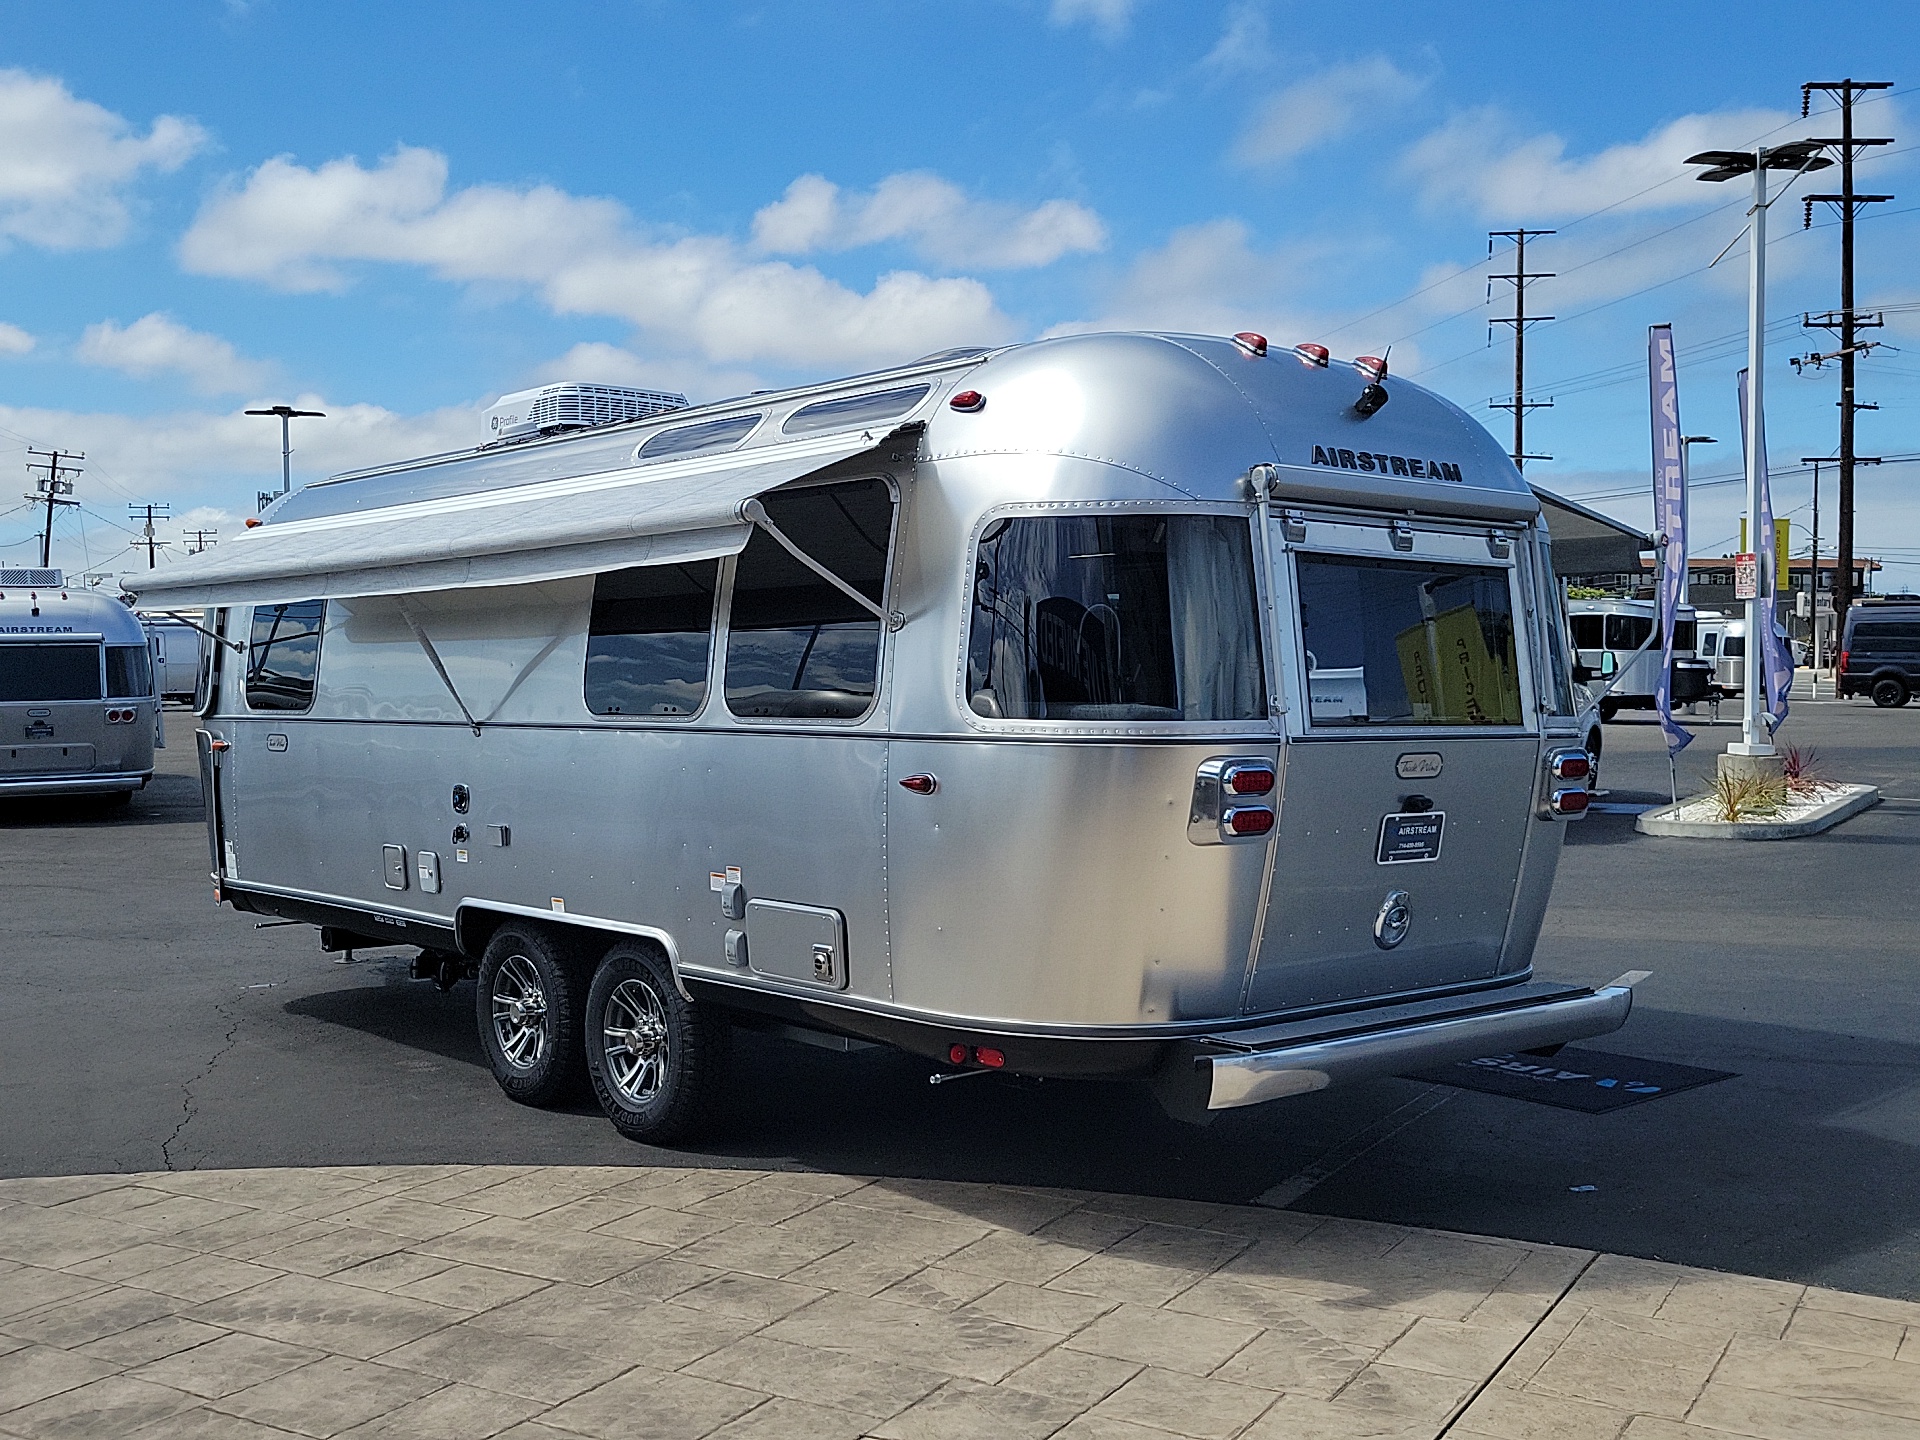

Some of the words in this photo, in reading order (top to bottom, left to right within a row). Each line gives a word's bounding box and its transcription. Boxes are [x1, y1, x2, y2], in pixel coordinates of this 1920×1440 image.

[499, 414, 519, 427] Profile
[1310, 444, 1463, 483] AIRSTREAM
[1398, 825, 1437, 835] AIRSTREAM
